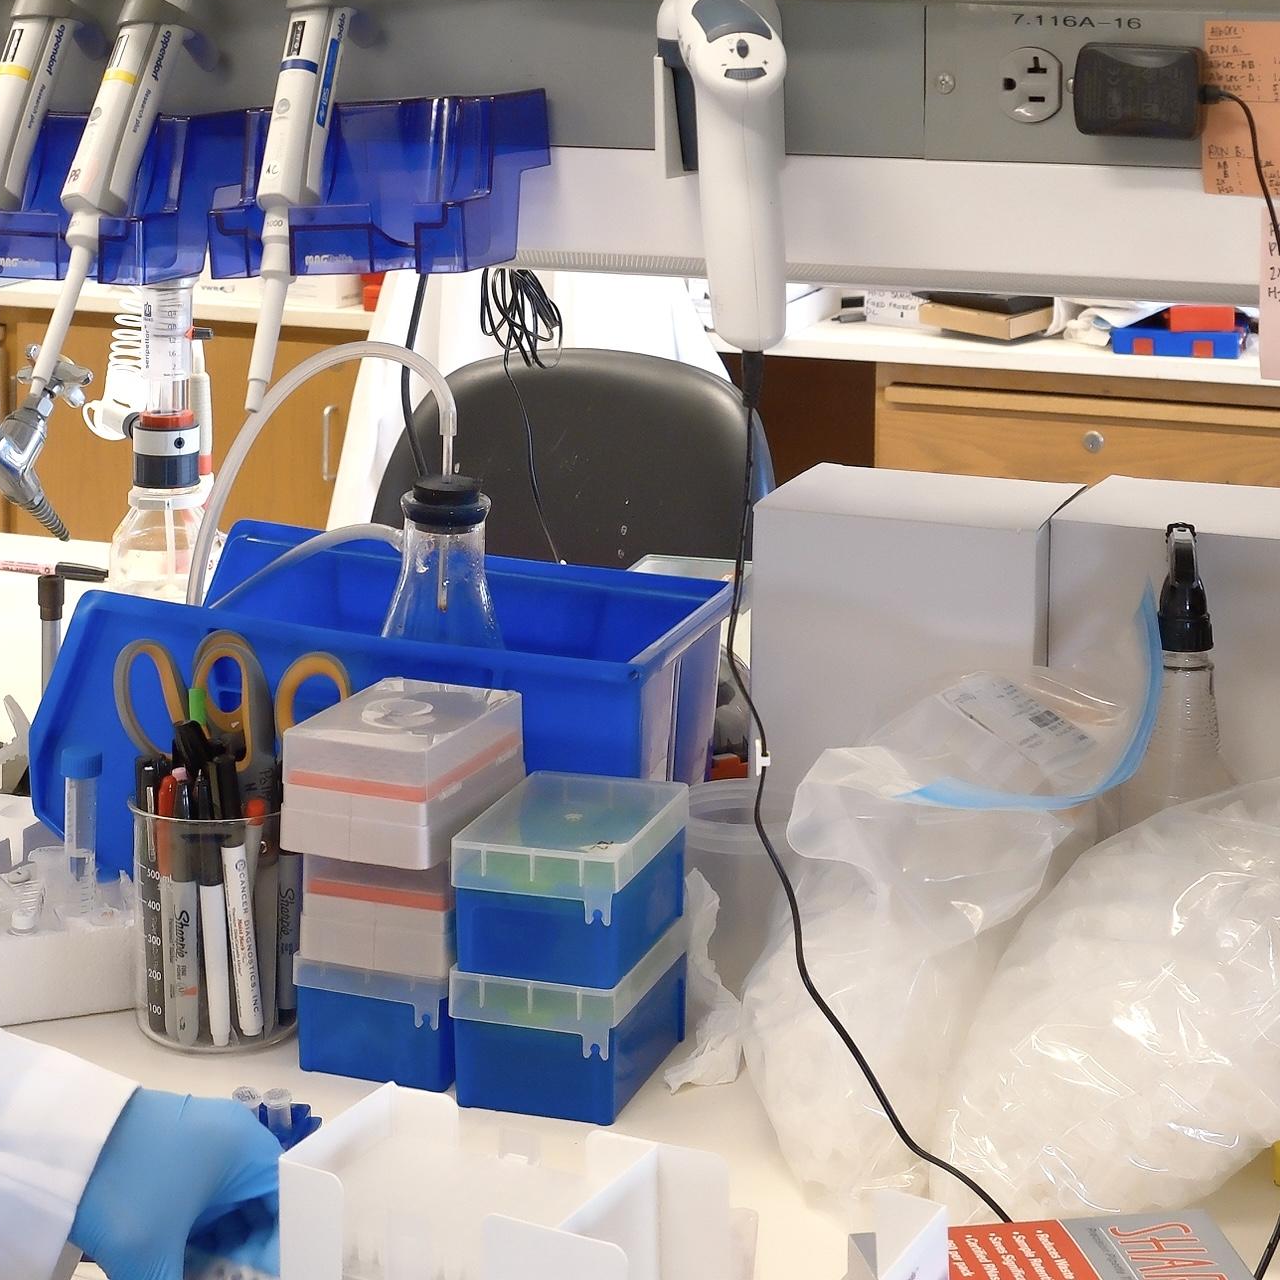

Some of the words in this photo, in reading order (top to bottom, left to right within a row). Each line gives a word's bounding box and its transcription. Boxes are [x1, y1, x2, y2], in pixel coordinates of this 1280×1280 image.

[1012, 13, 1142, 31] 7.116A-16
[42, 24, 66, 76] eppendorf
[151, 30, 172, 82] eppendorf
[146, 870, 160, 880] 500
[238, 872, 249, 914] CANCER
[147, 901, 160, 912] 400
[147, 936, 160, 946] 300
[148, 970, 162, 980] 200
[148, 1005, 162, 1015] 100
